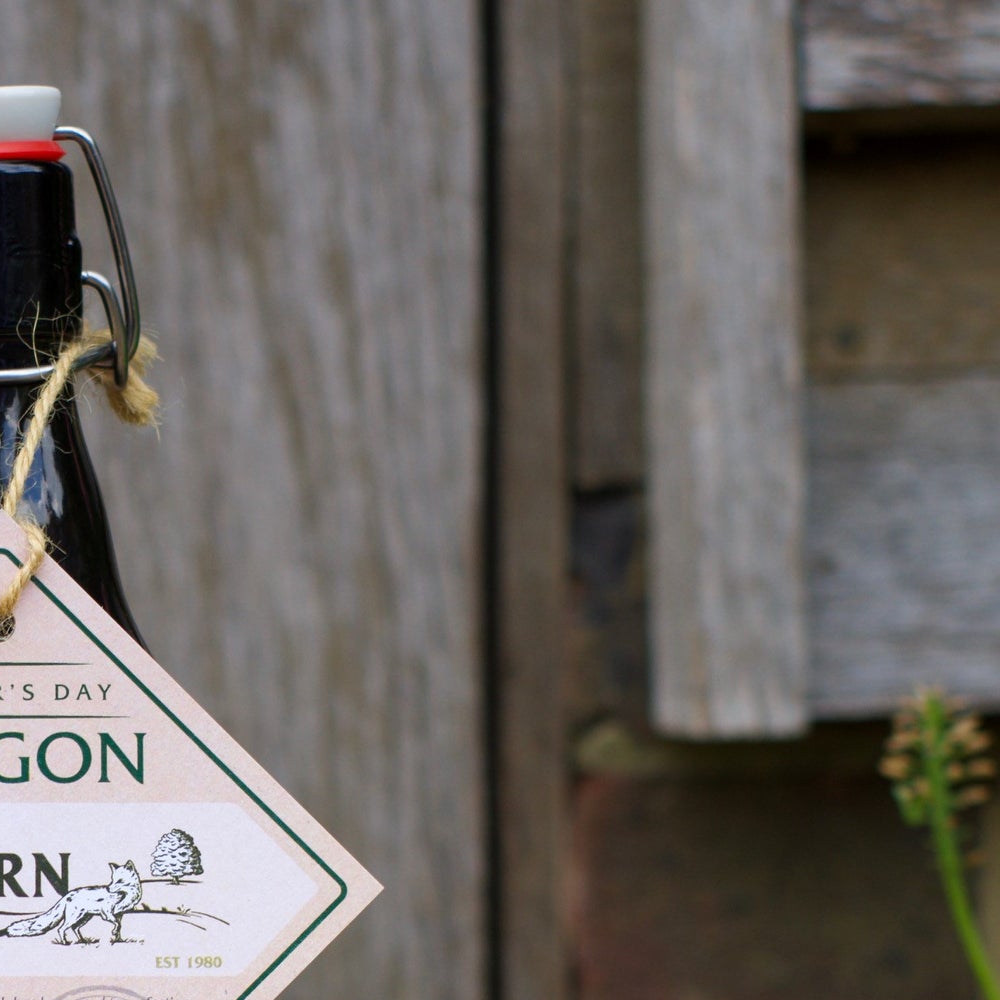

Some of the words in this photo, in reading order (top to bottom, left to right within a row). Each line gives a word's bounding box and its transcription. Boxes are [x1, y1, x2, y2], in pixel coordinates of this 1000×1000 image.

[55, 684, 112, 701] DAY
[155, 956, 179, 969] EST
[187, 956, 222, 969] 1980
